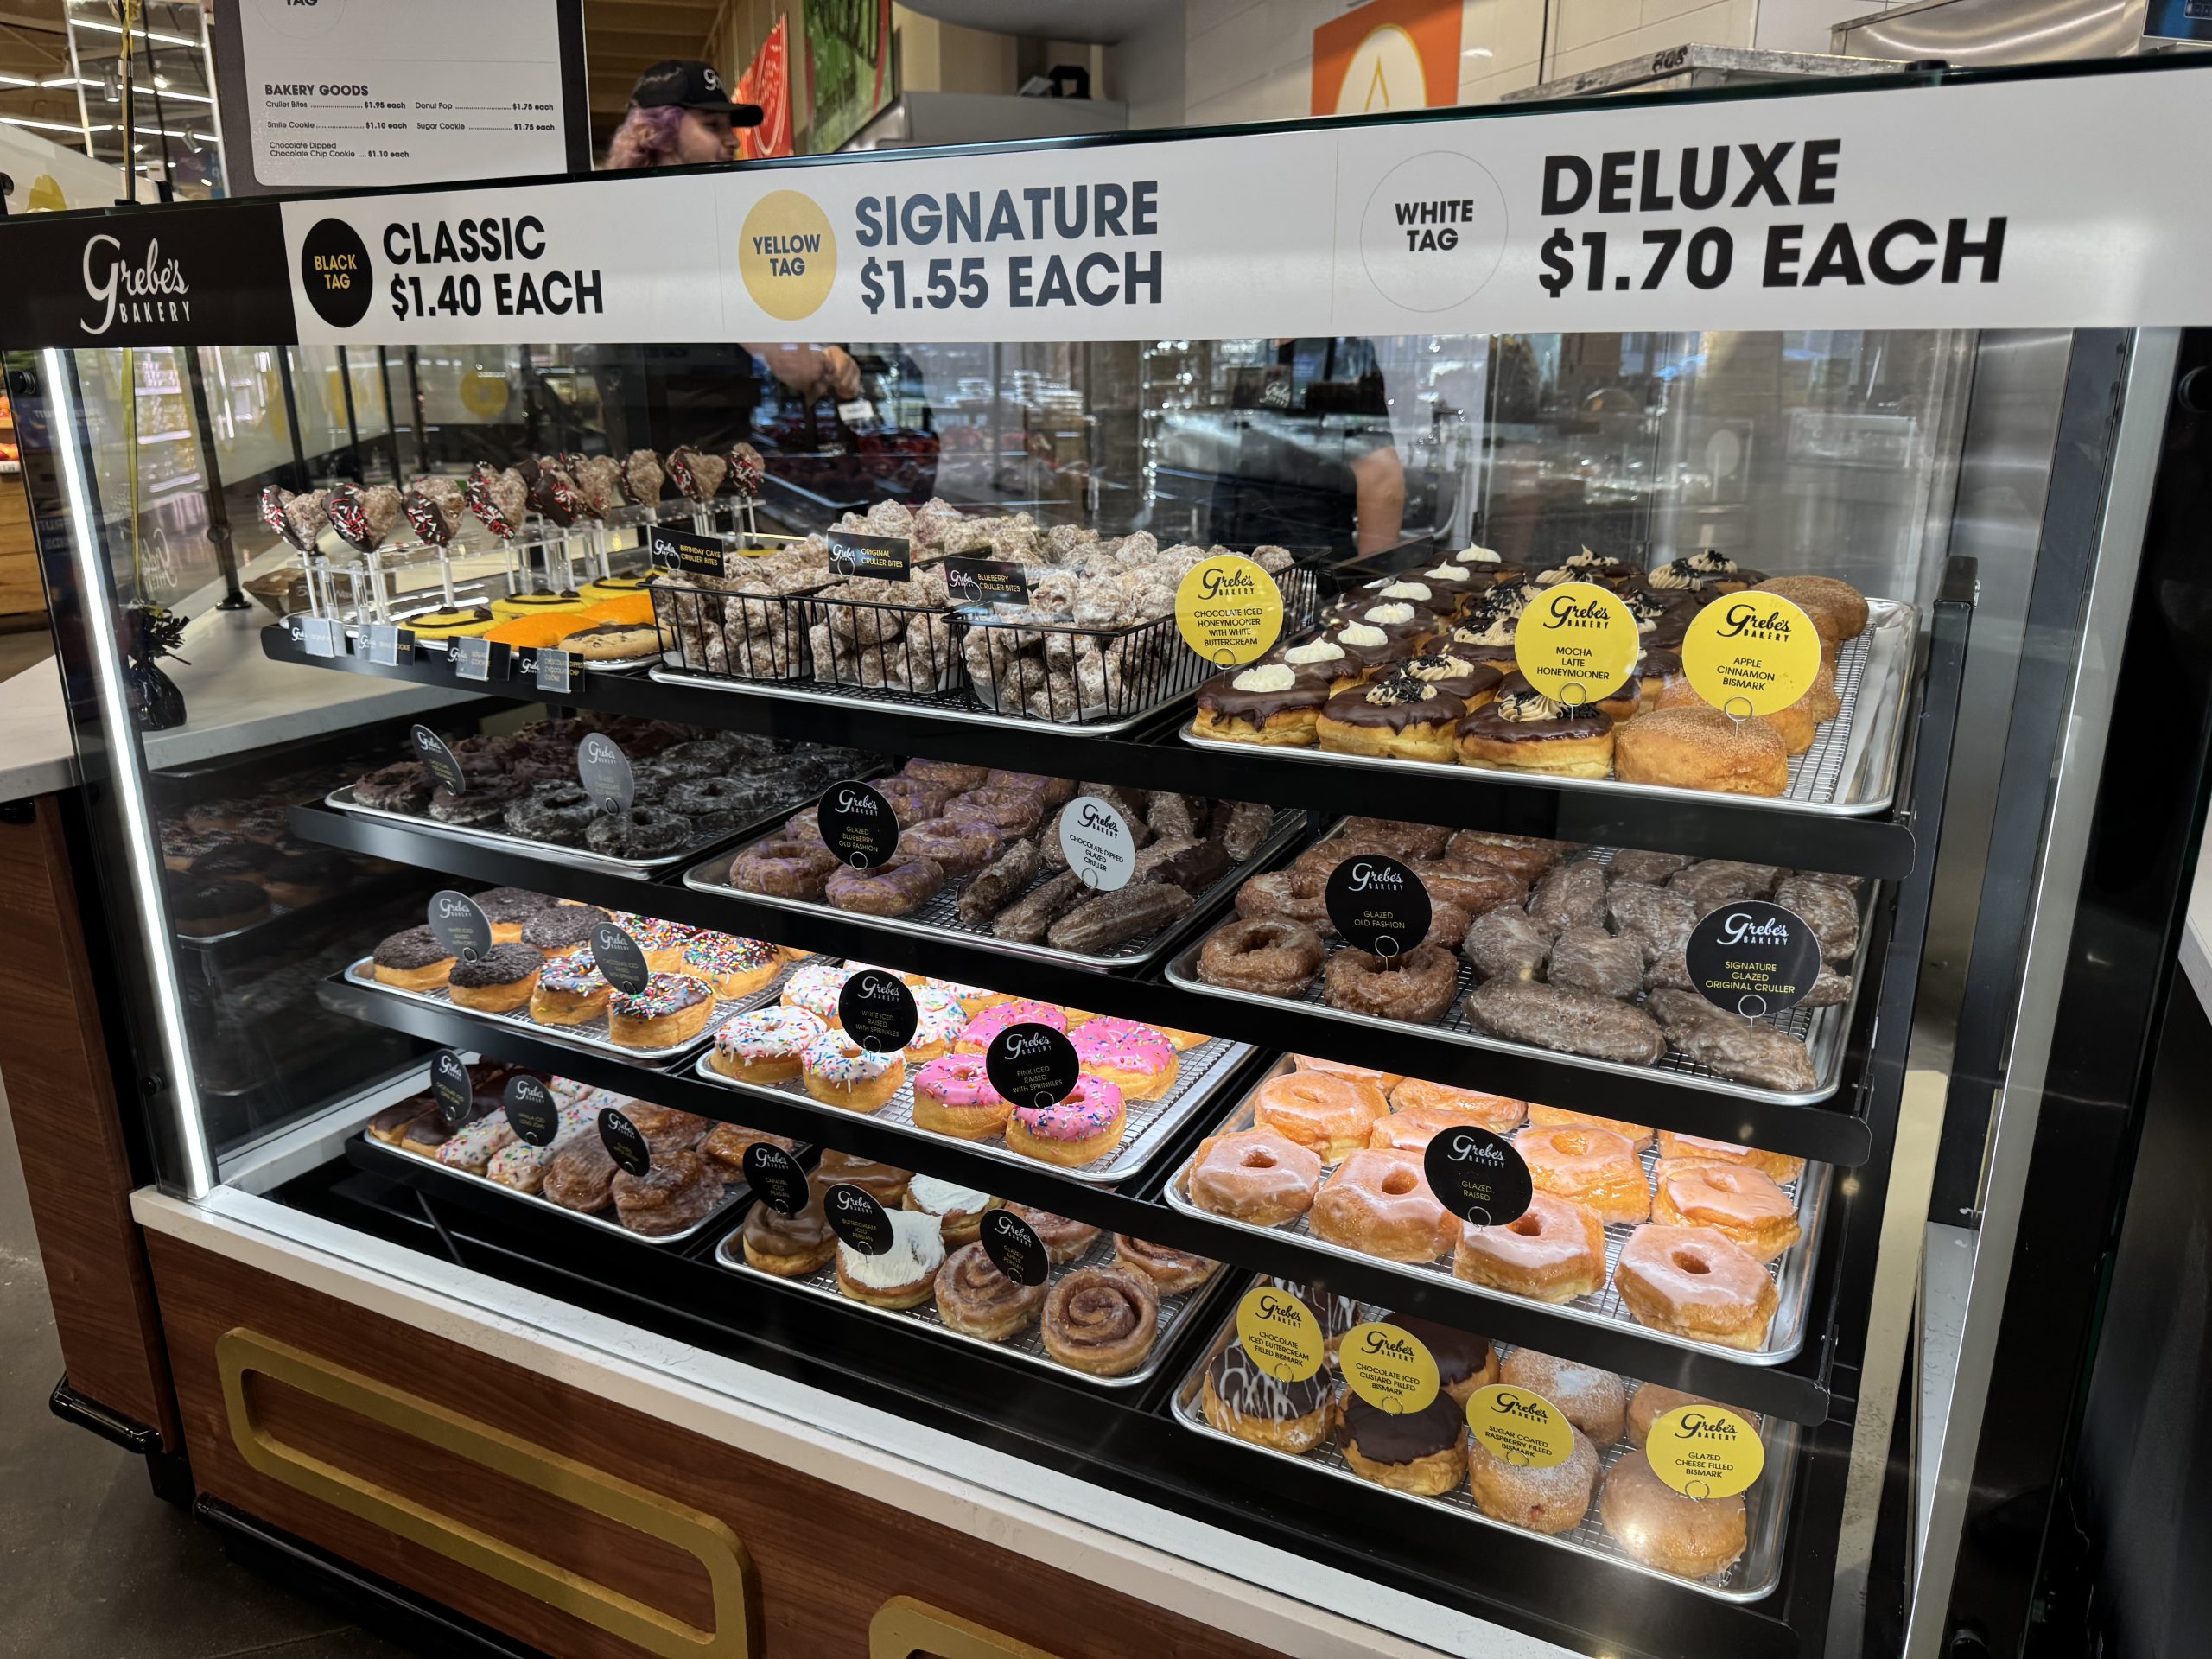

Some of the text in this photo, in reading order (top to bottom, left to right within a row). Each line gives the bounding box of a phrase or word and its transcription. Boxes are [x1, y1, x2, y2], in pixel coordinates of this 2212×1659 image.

[264, 84, 369, 96] BAKERY GOODS
[438, 102, 453, 111] Pop
[309, 142, 337, 150] Dipped
[310, 149, 327, 158] Chip
[1541, 138, 1842, 216] DELUXE
[855, 180, 1159, 248] SIGNATURE
[1395, 199, 1474, 226] WHITE
[383, 215, 546, 265] CLASSIC
[752, 234, 820, 255] YELLOW
[1406, 228, 1459, 252] TAG
[314, 253, 358, 271] BLACK
[1538, 216, 2009, 298] $1.70 EACH
[769, 257, 805, 277] TAG
[80, 234, 190, 335] Grebe's
[324, 273, 351, 289] TAG
[861, 251, 1163, 315] $1.55 EACH
[390, 270, 604, 321] $1.40 EACH
[119, 301, 191, 324] BAKERY
[679, 544, 705, 556] BIRTHDAY
[705, 550, 721, 558] CAKE
[861, 548, 891, 558] ORIGINAL
[680, 553, 703, 563] CRULLER
[704, 557, 718, 566] BITES
[861, 557, 887, 566] CRULLER
[887, 559, 904, 568] BITES
[977, 573, 1009, 582] BLUEBERRY
[1198, 568, 1255, 601] Grebe's
[979, 582, 1005, 591] CRULLER
[1193, 607, 1262, 619] CHOCOLATE ICED
[1542, 595, 1611, 629] Grebe's
[1198, 618, 1261, 627] HONEYMOONER
[1567, 619, 1609, 629] BAKERY
[1716, 604, 1791, 638] Grebe's
[1208, 627, 1251, 637] WITH WHITE
[1743, 628, 1789, 643] BAKERY
[1204, 638, 1258, 646] BUTTERCREAM
[1555, 646, 1592, 657] MOCHA
[1561, 658, 1586, 667] LATTE
[1733, 657, 1763, 668] APPLE
[1536, 666, 1610, 680] HONEYMOONER
[1716, 665, 1776, 682] CINNAMON
[1722, 677, 1766, 691] BISMARK
[846, 825, 869, 836] GLAZED
[842, 833, 874, 843] BLUEBERRY
[852, 842, 879, 853] FASHION
[1069, 834, 1124, 863] CHOCOLATE DIPPED
[1085, 849, 1107, 863] GLAZED
[1084, 856, 1107, 872] CRULLER
[1348, 862, 1403, 892] Grebe's
[1368, 882, 1403, 892] BAKERY
[1363, 910, 1394, 919] GLAZED
[1354, 918, 1405, 929] OLD FASHION
[1716, 912, 1789, 945] Grebe's
[1743, 935, 1788, 946] BAKERY
[1725, 961, 1777, 972] SIGNATURE
[1732, 971, 1770, 982] GLAZED
[1705, 980, 1796, 994] ORIGINAL CRULLER
[861, 1009, 894, 1021] WHITE ICED
[868, 1018, 887, 1027] RAISED
[855, 1023, 899, 1037] WITH SPRINKLES
[1017, 1065, 1050, 1077] PINK ICED
[1012, 1078, 1063, 1094] WITH SPRINKLES
[1024, 1074, 1047, 1084] RAISED
[1447, 1135, 1505, 1161] Grebe's
[1469, 1155, 1505, 1169] BAKERY
[1461, 1180, 1492, 1193] GLAZED
[1463, 1189, 1491, 1201] RAISED
[1003, 1244, 1024, 1259] GLAZED
[1259, 1331, 1299, 1349] CHOCOLATE
[1361, 1331, 1415, 1357] Grebe's
[1249, 1335, 1310, 1361] ICED BUTTERCREAM
[1255, 1345, 1303, 1367] FILLED BISMARK
[1355, 1363, 1421, 1385] CHOCOLATE ICED
[1359, 1371, 1416, 1392] CUSTARD FILLED
[1371, 1382, 1404, 1396] BISMARK
[1674, 1413, 1738, 1439] Grebe's
[1484, 1431, 1553, 1456] RASPBERRY FILLED
[1489, 1425, 1549, 1448] SUGAR COATED
[1501, 1443, 1535, 1458] BISMARK
[1688, 1452, 1721, 1461] GLAZED
[1675, 1459, 1734, 1471] CHEESE FILLED
[1686, 1468, 1723, 1478] BISMARK
